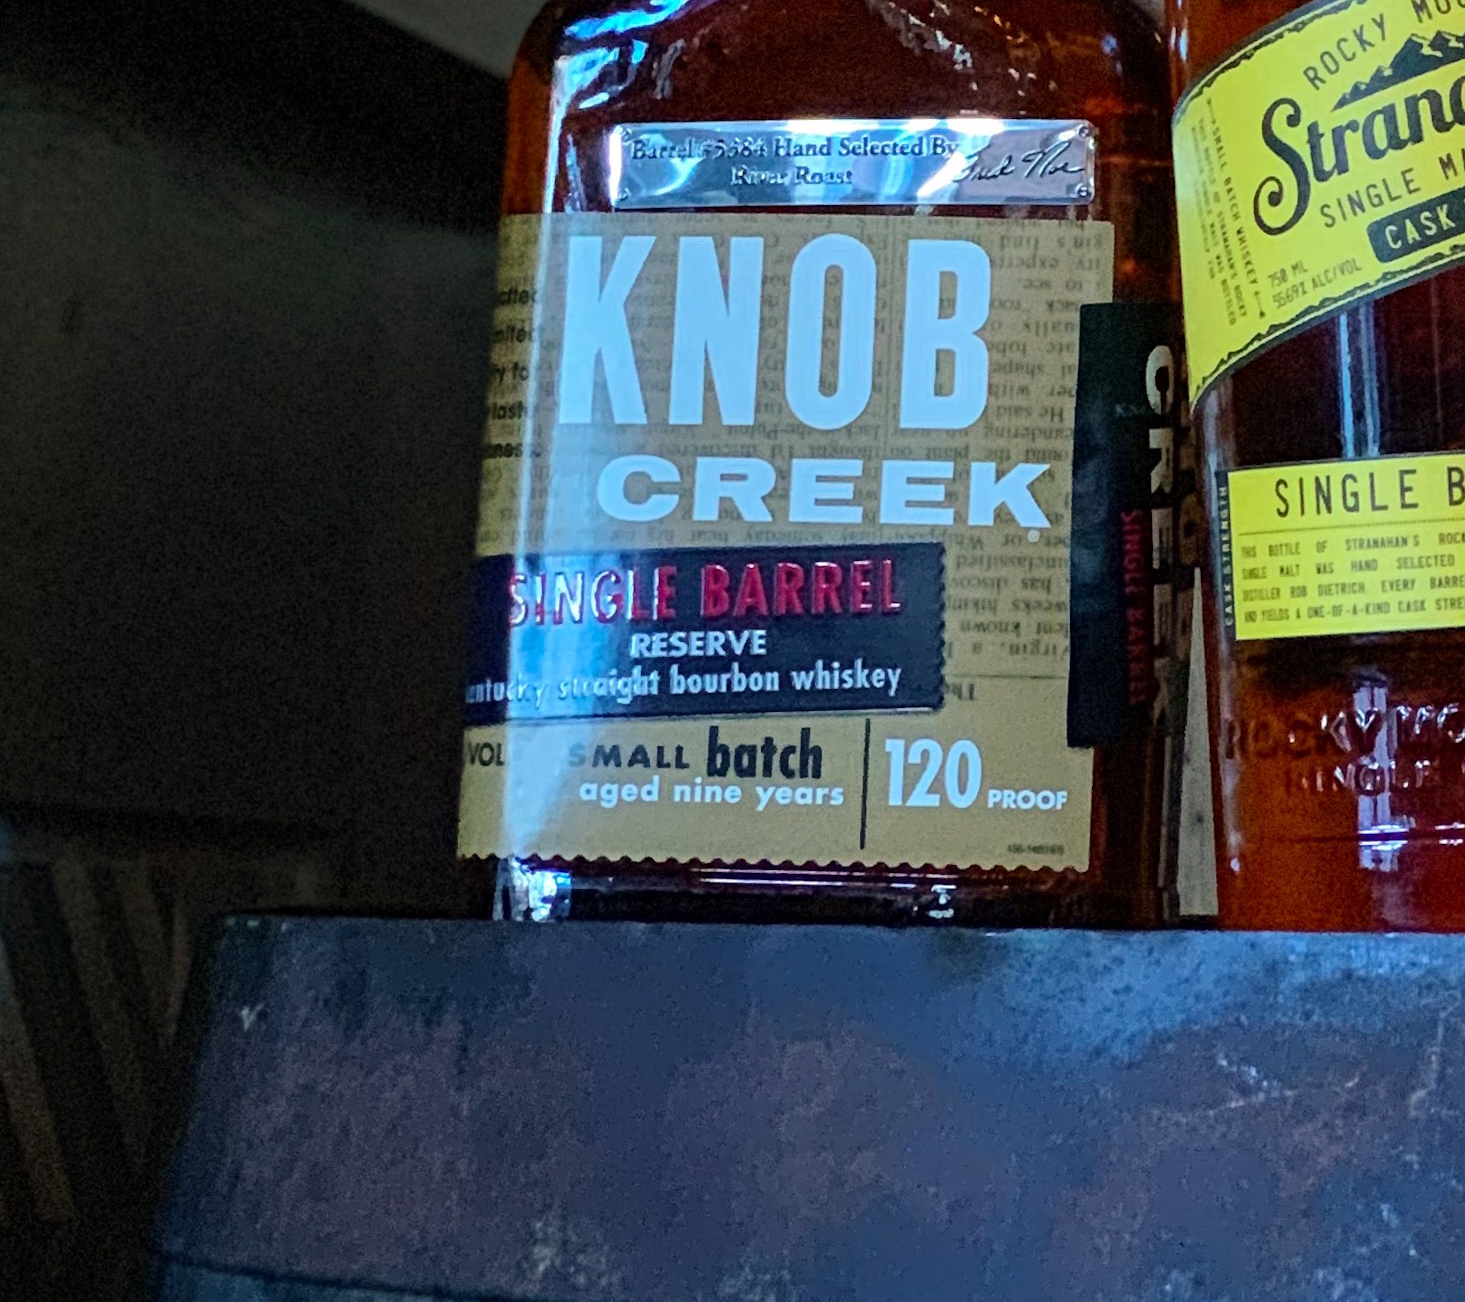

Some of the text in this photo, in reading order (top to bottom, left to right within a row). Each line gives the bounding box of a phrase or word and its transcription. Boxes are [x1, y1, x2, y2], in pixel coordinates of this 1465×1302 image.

[1304, 14, 1390, 91] ROCKY
[775, 138, 830, 158] Hand
[840, 136, 924, 158] Selected
[931, 137, 960, 162] By
[794, 166, 853, 185] Roast
[1320, 168, 1422, 228] SINGLE
[1385, 206, 1452, 249] CASK
[1236, 227, 1259, 285] WHISKEY
[558, 233, 991, 429] KNOB
[598, 456, 1053, 529] CREEK
[1275, 469, 1419, 518] SINGLE
[1269, 542, 1301, 557] BOTTLE
[1316, 540, 1328, 553] OF
[1345, 535, 1420, 551] STRANAHAN'S
[1279, 564, 1300, 578] MALT
[1316, 562, 1334, 575] WAS
[1350, 559, 1378, 572] HAND
[1397, 554, 1455, 570] SELECTED
[508, 559, 902, 629] SINGLE BARREL
[1318, 582, 1365, 596] DIETRICH
[1381, 578, 1416, 592] EVERY
[1398, 600, 1426, 612] CASK
[630, 630, 767, 658] RESERVE
[557, 666, 661, 705] straight
[670, 663, 780, 694] bourbon
[791, 659, 902, 696] whiskey
[569, 744, 690, 770] SMALL
[707, 726, 822, 779] batch
[885, 738, 1068, 809] 120 PROOF
[579, 775, 845, 811] aged nine years
